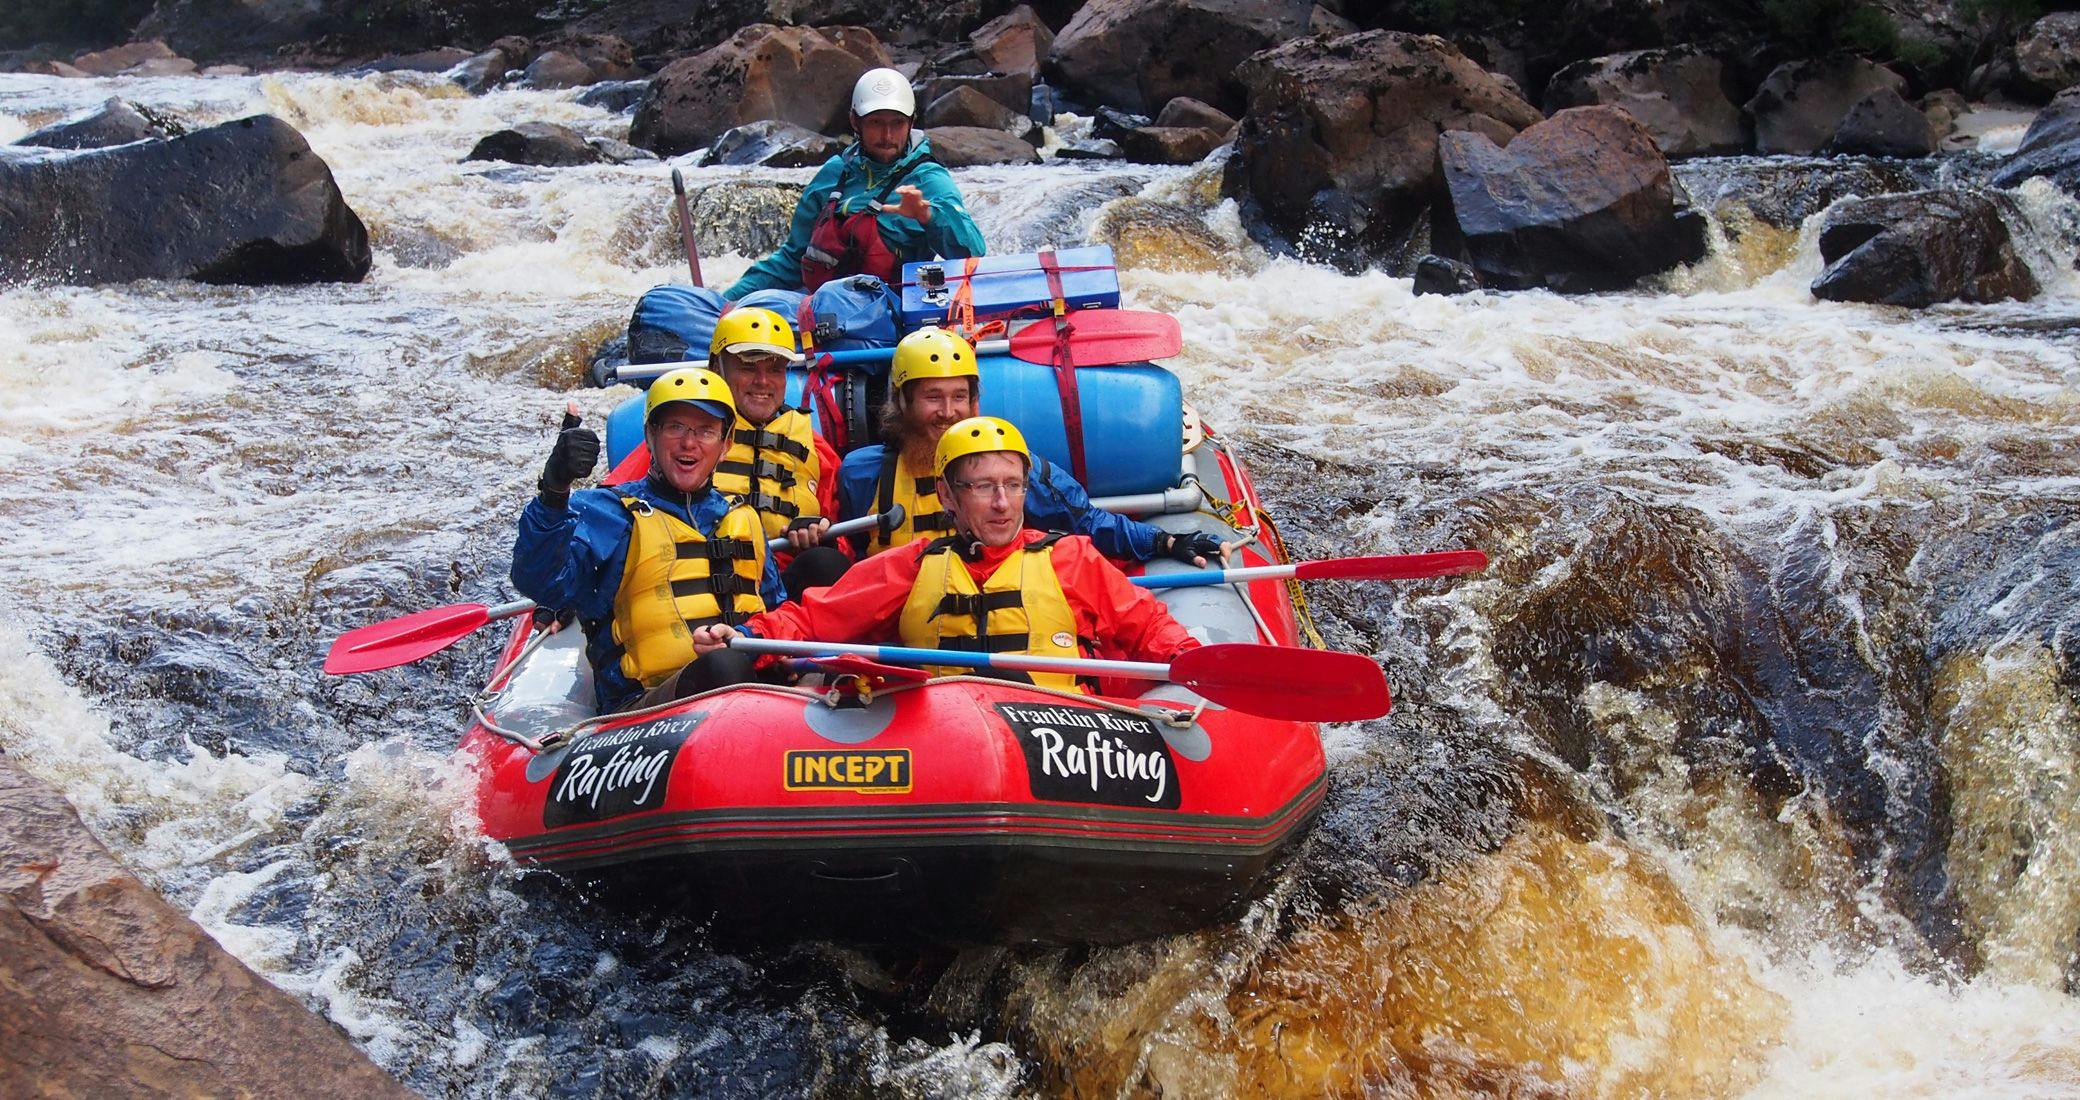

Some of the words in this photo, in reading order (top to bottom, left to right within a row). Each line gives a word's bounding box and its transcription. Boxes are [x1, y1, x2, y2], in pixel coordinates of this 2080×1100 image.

[572, 725, 646, 754] Franklin
[644, 718, 698, 739] River
[1001, 706, 1099, 729] Franklin
[1095, 712, 1152, 734] River
[556, 744, 670, 810] Rafting
[794, 755, 905, 783] INCEPT
[1030, 727, 1166, 803] Rafting
